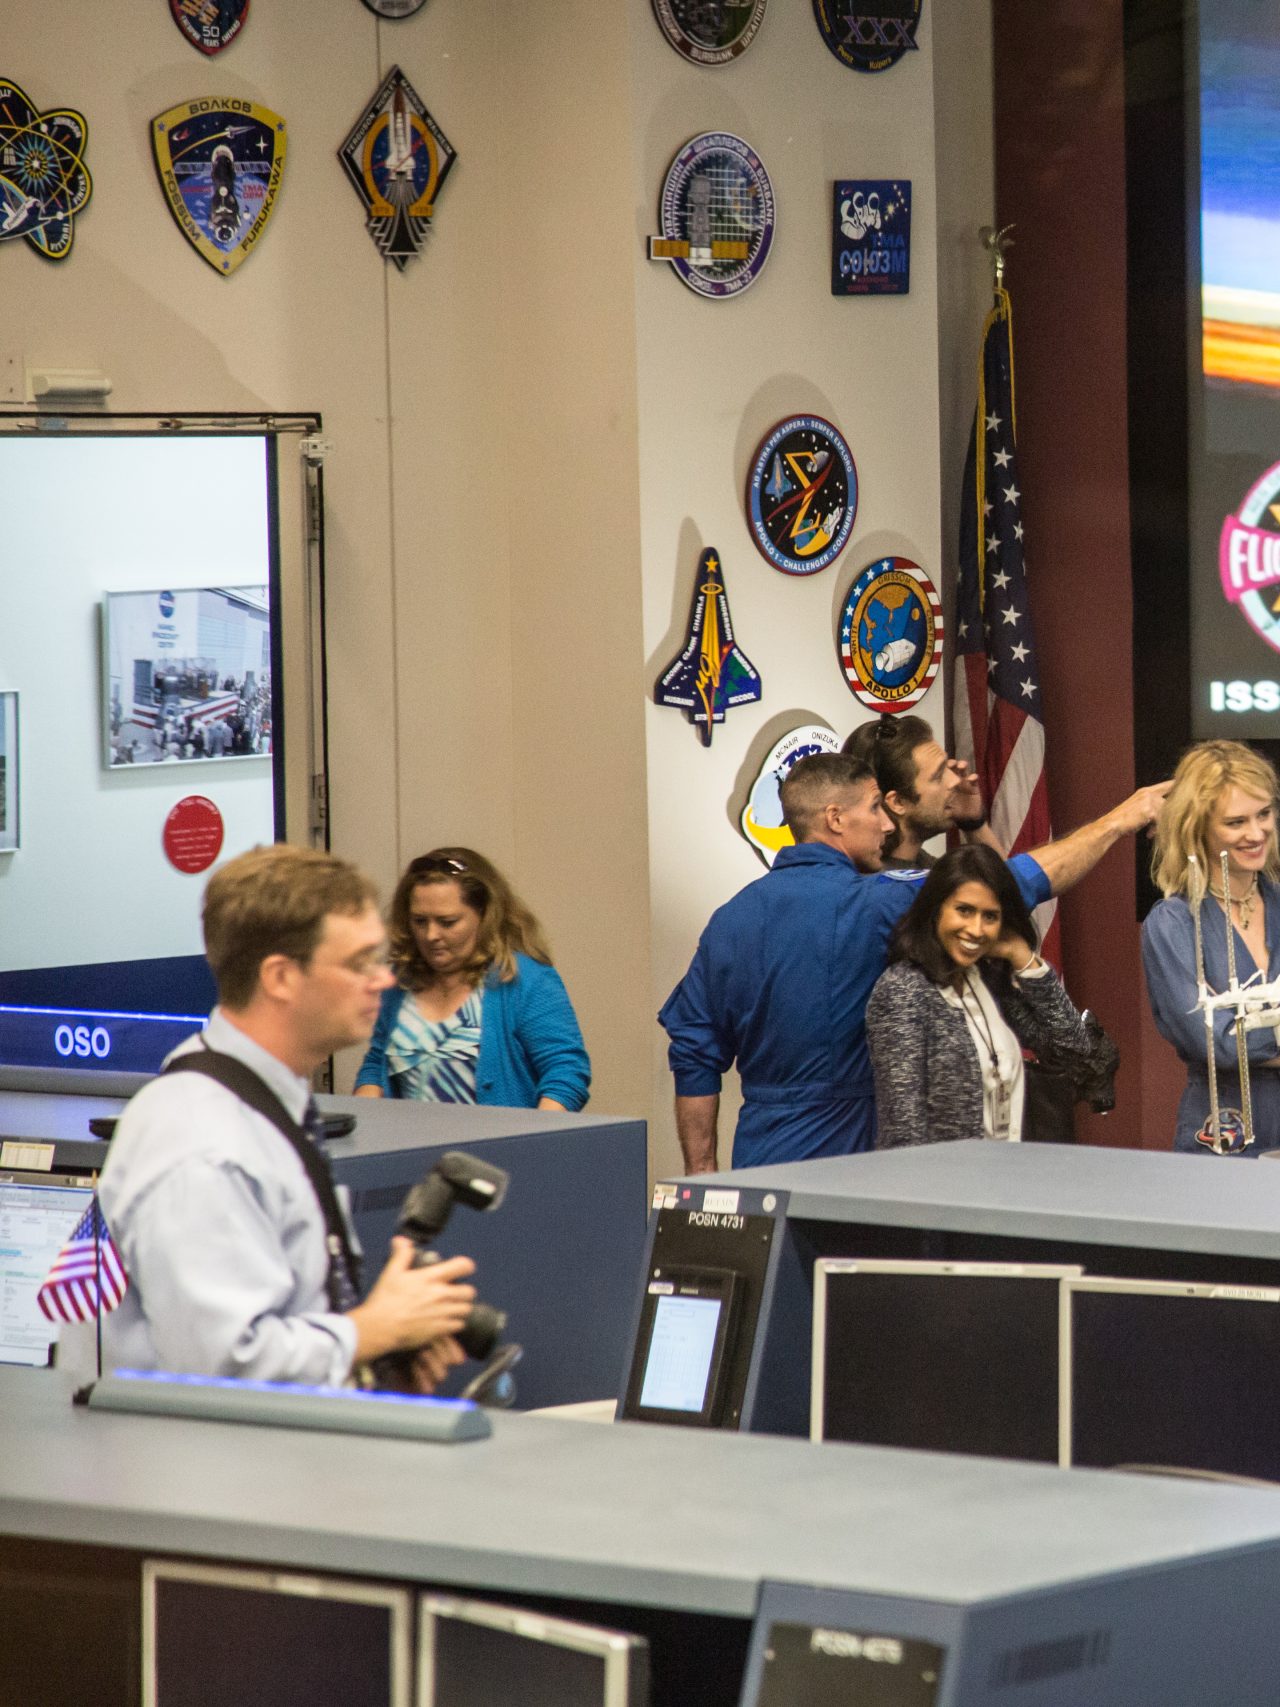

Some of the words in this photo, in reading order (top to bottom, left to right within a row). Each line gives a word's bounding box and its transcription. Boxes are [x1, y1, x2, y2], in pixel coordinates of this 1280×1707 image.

[203, 26, 220, 38] 50
[163, 169, 201, 242] FOSSUM
[241, 155, 283, 252] FURUKAWA
[756, 169, 774, 226] BURBANK
[756, 447, 771, 474] ASTRA
[769, 434, 782, 449] PER
[781, 420, 806, 437] ASPERA
[810, 420, 835, 439] SEMPER
[833, 435, 852, 473] EXPLORO
[755, 521, 775, 556] APOLLO
[832, 505, 854, 551] COLUMBIA
[783, 554, 829, 571] CHALLENGER
[878, 573, 912, 584] GRISSOM
[718, 595, 733, 641] ANDERSON
[850, 624, 858, 656] WHITE
[865, 680, 911, 699] APOLLO
[775, 736, 799, 760] MCNAIR
[811, 731, 839, 749] ONIZUKA
[54, 1024, 111, 1059] OSO
[688, 1211, 719, 1227] POSN
[720, 1214, 744, 1229] 4731
